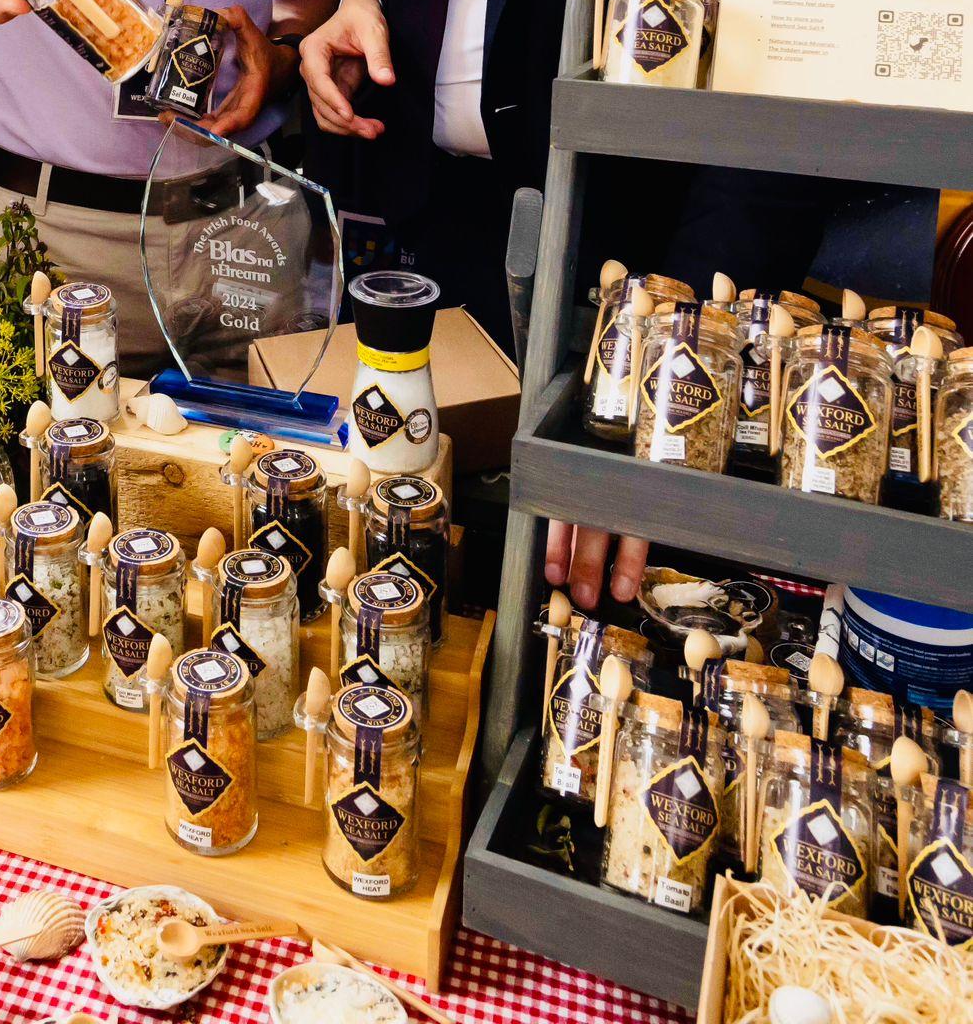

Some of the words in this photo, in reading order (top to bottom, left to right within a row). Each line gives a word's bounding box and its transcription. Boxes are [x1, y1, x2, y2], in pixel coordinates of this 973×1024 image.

[635, 30, 682, 46] EXFORD
[635, 41, 647, 49] EA
[648, 43, 673, 53] SALT
[179, 51, 212, 71] WEXFORD
[193, 234, 208, 254] The
[206, 216, 229, 236] Irish
[230, 215, 260, 231] Food
[258, 226, 287, 267] Awards
[208, 239, 257, 265] Blas
[257, 257, 274, 268] na
[222, 293, 258, 311] 2024
[219, 313, 260, 332] Gold
[52, 363, 95, 377] WEXFORD
[650, 379, 713, 401] WXFORD
[675, 395, 703, 408] SALT
[355, 405, 398, 427] WEXFORD
[796, 404, 865, 427] WXFORD
[357, 416, 370, 428] SEA
[370, 422, 390, 434] SALT
[824, 419, 854, 434] SALT
[110, 643, 125, 655] SEA
[125, 647, 146, 659] SALT
[170, 764, 224, 789] WEXFORD
[176, 779, 192, 792] SEA
[192, 785, 215, 797] SALT
[650, 793, 714, 826] WEXFORD
[338, 809, 398, 831] WEXFORD
[682, 819, 707, 835] SALT
[179, 823, 212, 838] WEXFORD
[186, 833, 204, 843] HEAT
[344, 824, 363, 836] SEA
[363, 828, 389, 840] SALT
[797, 860, 813, 873] EA
[353, 877, 389, 885] WEXFORD
[362, 885, 381, 893] HEAT
[661, 881, 690, 896] Tomato
[664, 895, 685, 908] Basil
[205, 927, 239, 937] Wexford
